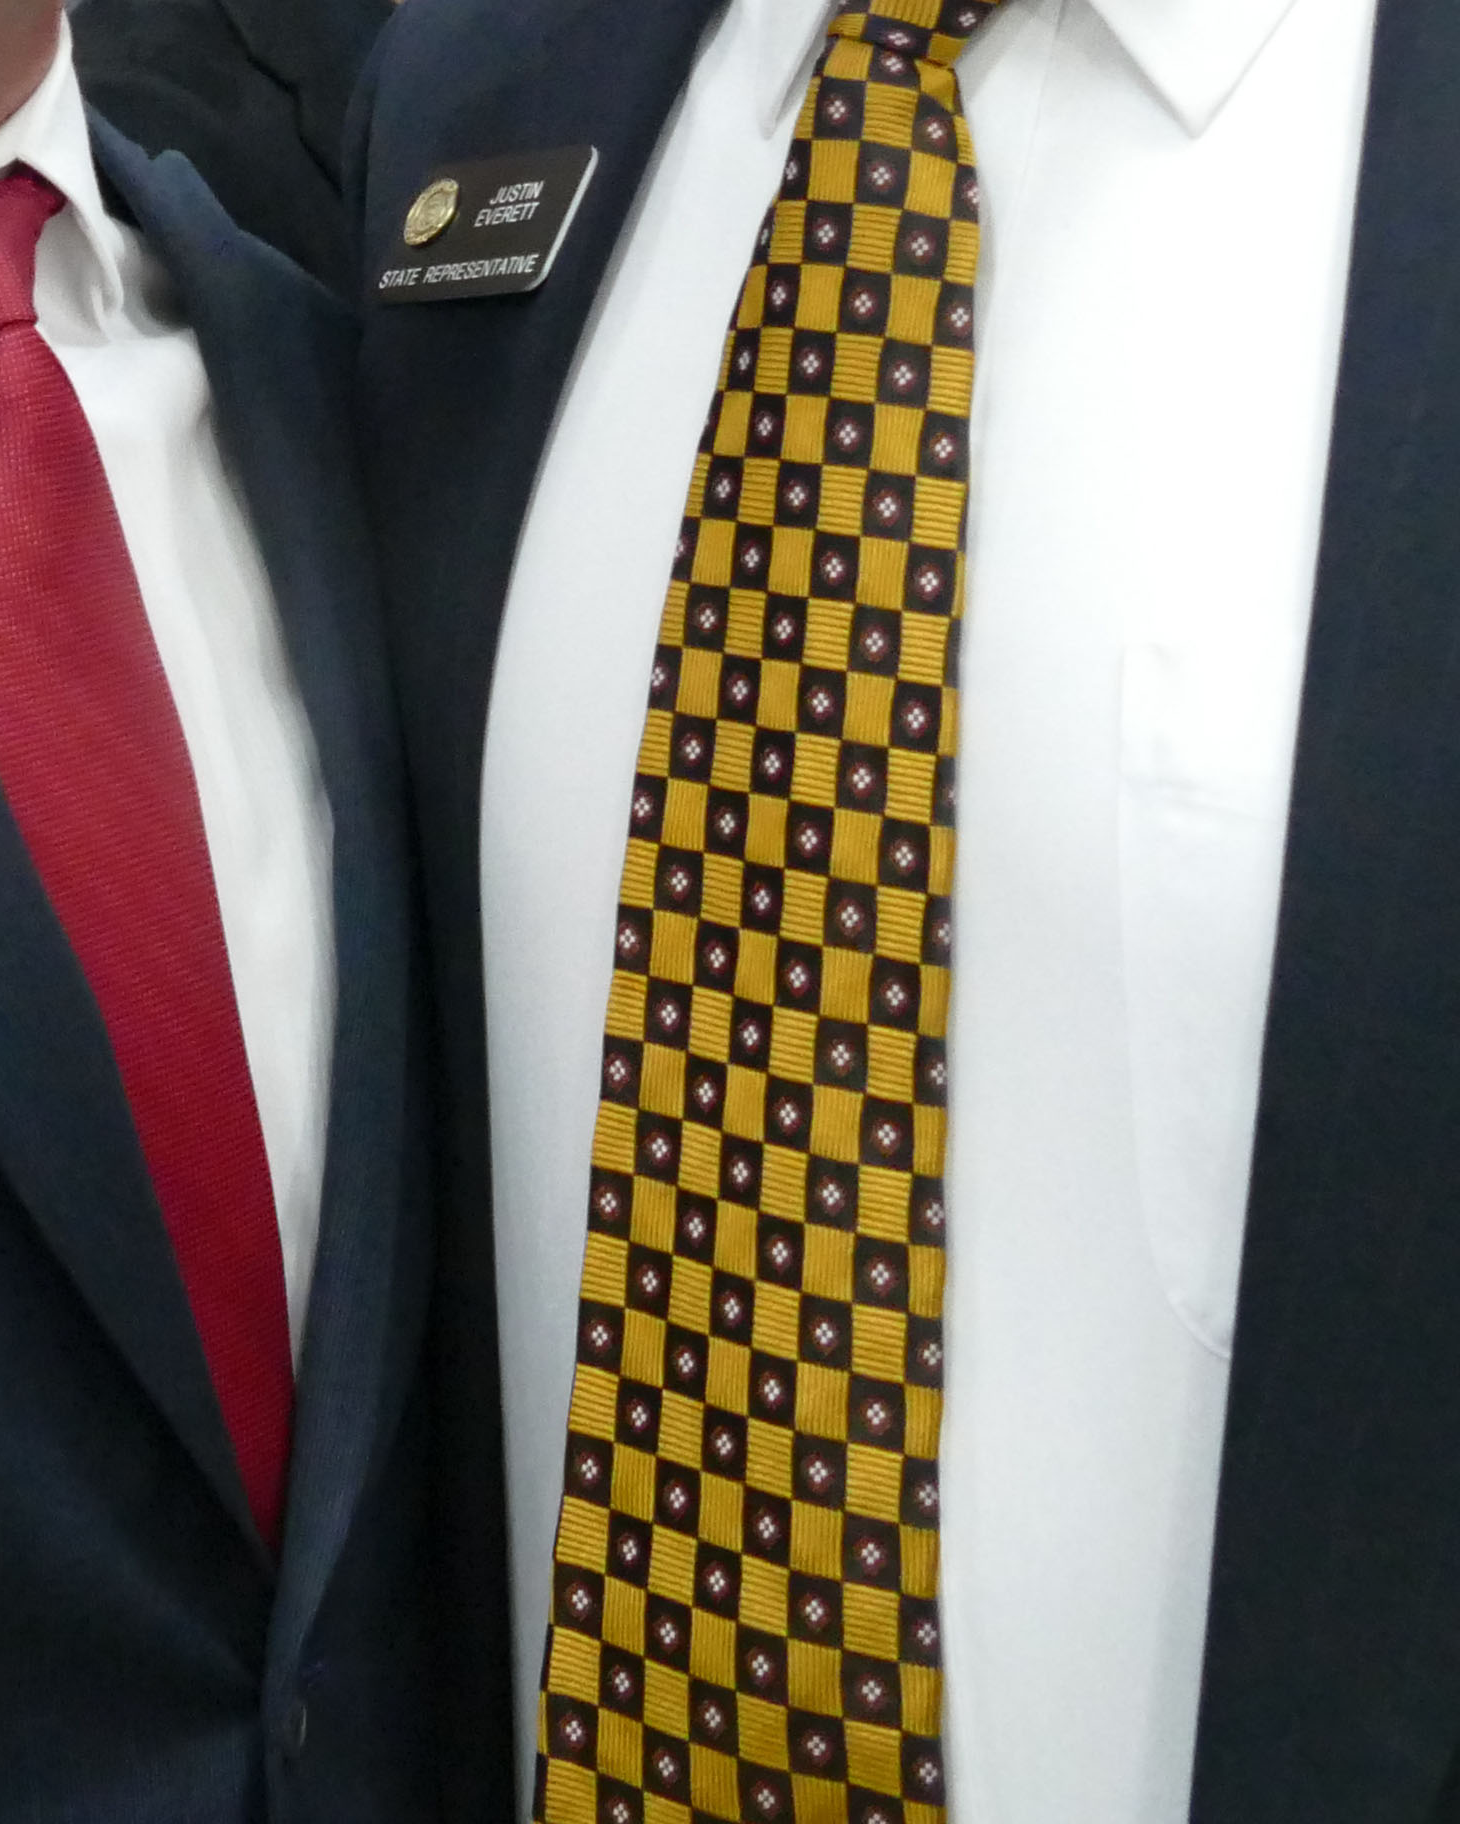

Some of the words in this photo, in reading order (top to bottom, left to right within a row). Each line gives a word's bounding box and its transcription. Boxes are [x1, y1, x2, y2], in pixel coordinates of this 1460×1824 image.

[489, 180, 544, 205] JUSTIN
[473, 202, 540, 227] EVERETT
[378, 267, 422, 289] STATE
[423, 254, 539, 284] REPRESENTATIVE
